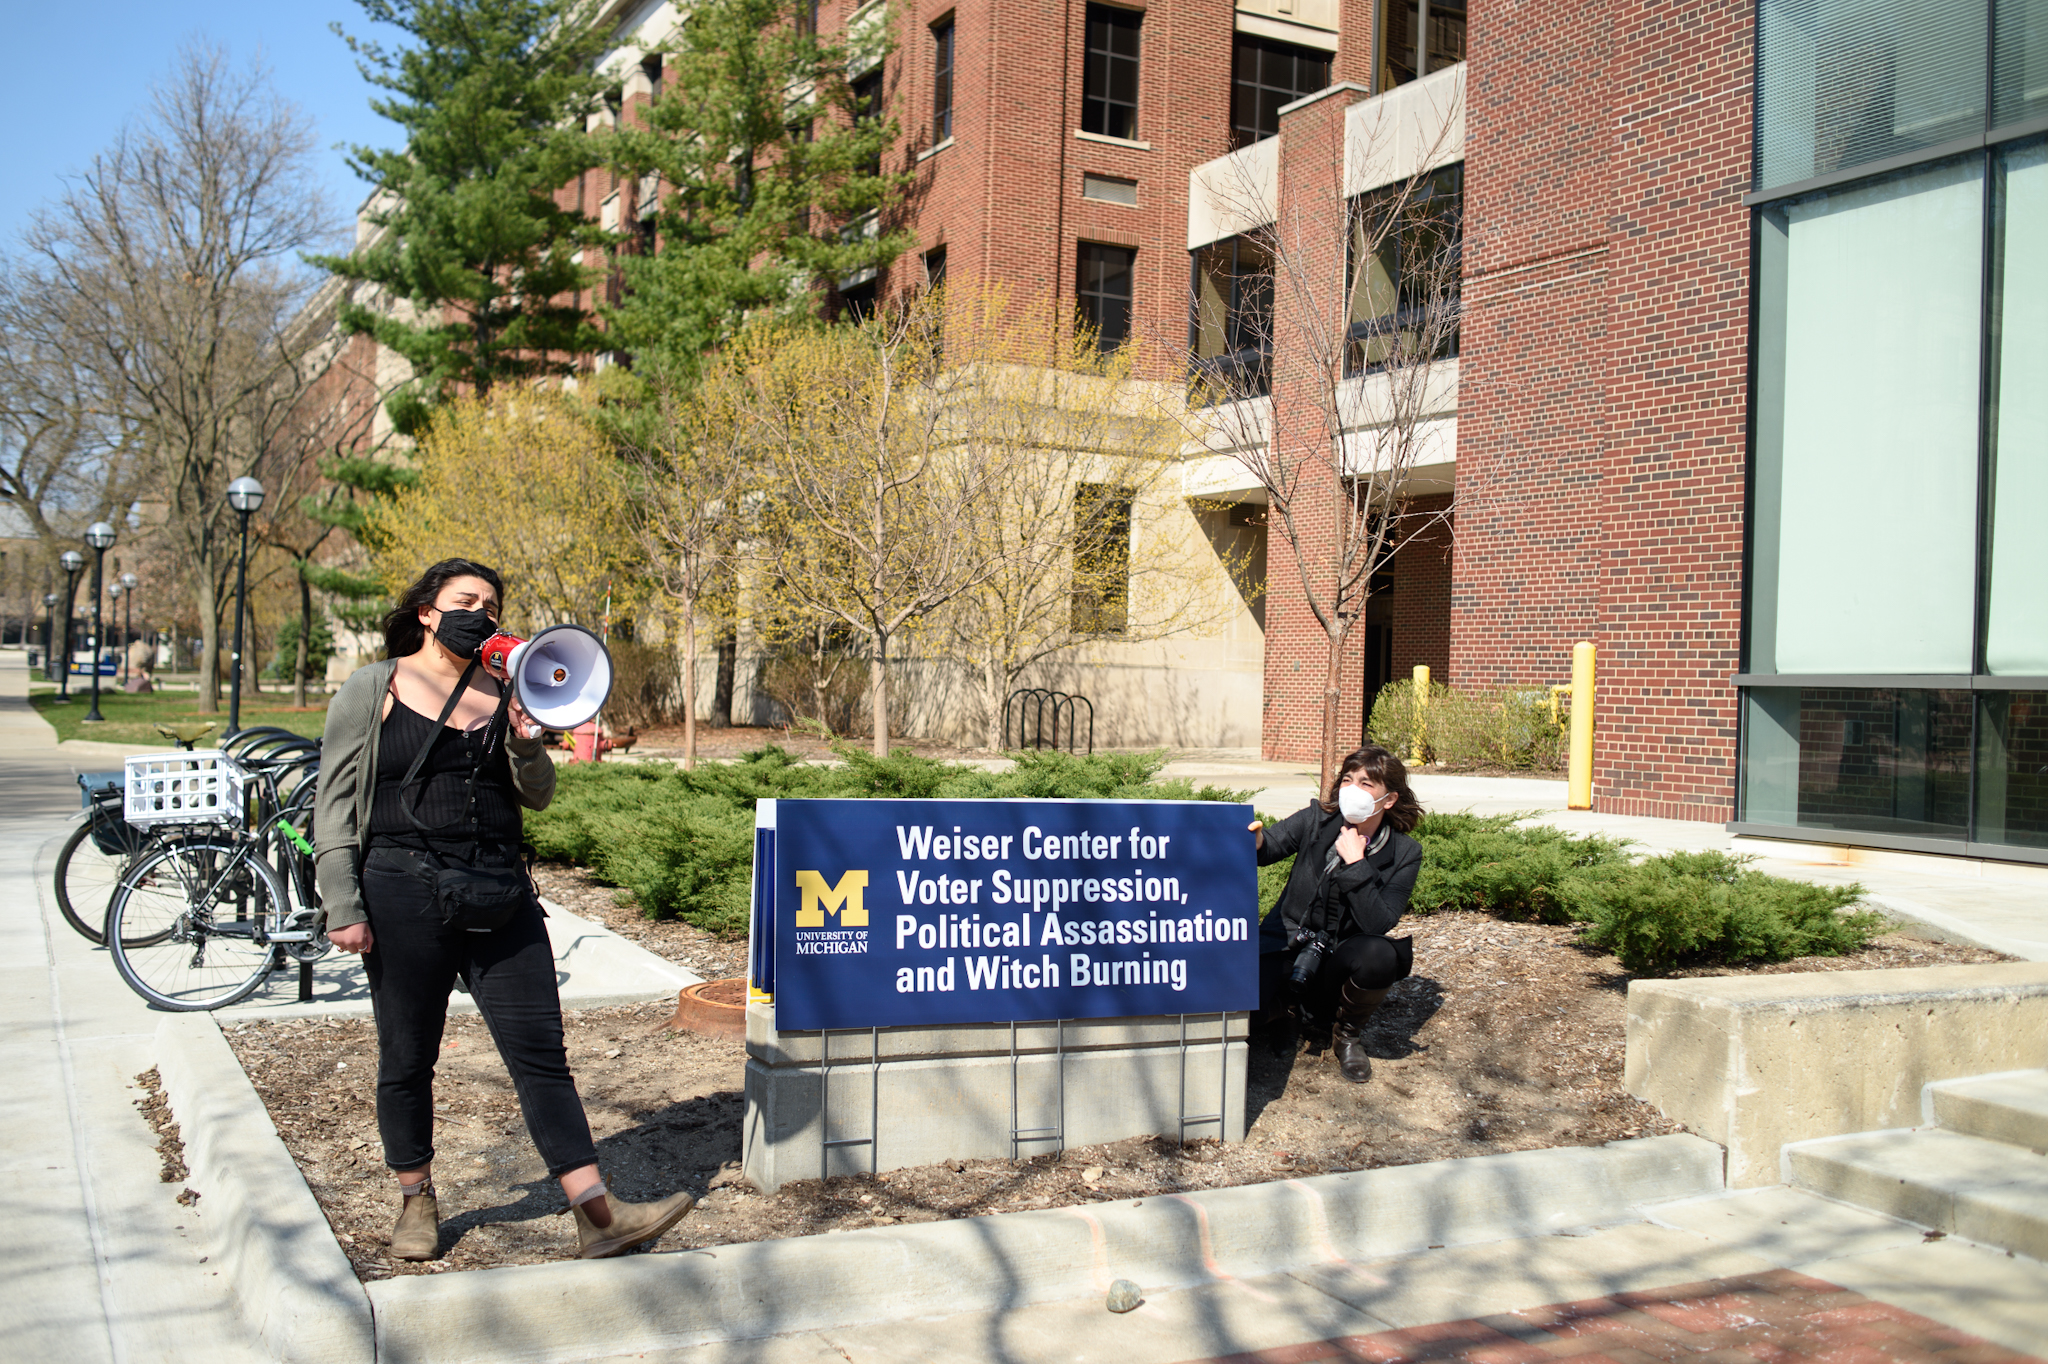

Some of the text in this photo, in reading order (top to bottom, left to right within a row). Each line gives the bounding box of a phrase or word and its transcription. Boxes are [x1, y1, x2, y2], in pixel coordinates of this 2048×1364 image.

[896, 825, 1171, 860] Weiser Center for
[795, 869, 870, 928] M
[896, 868, 1189, 913] Voter Suppression,
[795, 930, 869, 941] UNIVERSITY OF
[795, 940, 869, 955] MICHIGAN
[896, 910, 1248, 950] Political Assassination
[895, 951, 1188, 994] and Witch Burning
